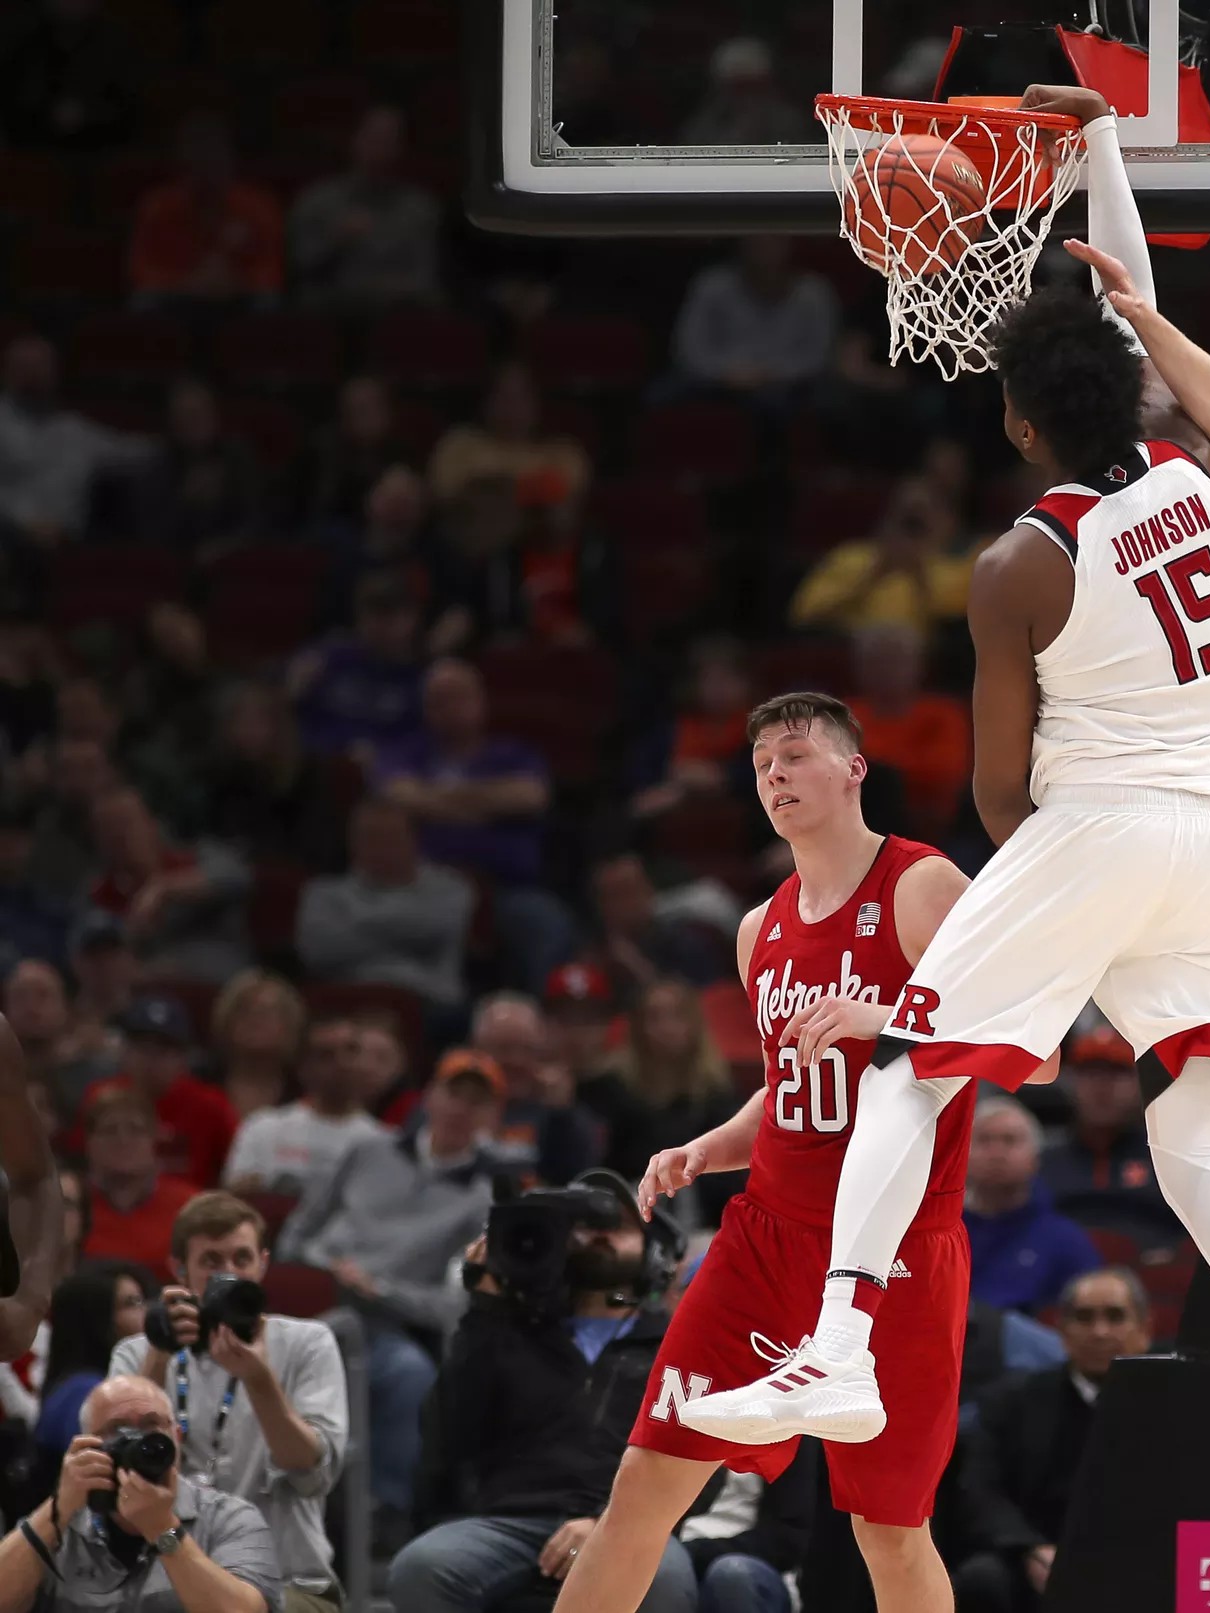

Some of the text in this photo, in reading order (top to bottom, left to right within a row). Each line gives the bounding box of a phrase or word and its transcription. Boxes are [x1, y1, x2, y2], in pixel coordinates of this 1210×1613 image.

[891, 984, 941, 1037] R
[776, 1046, 849, 1133] 20
[649, 1365, 713, 1428] N
